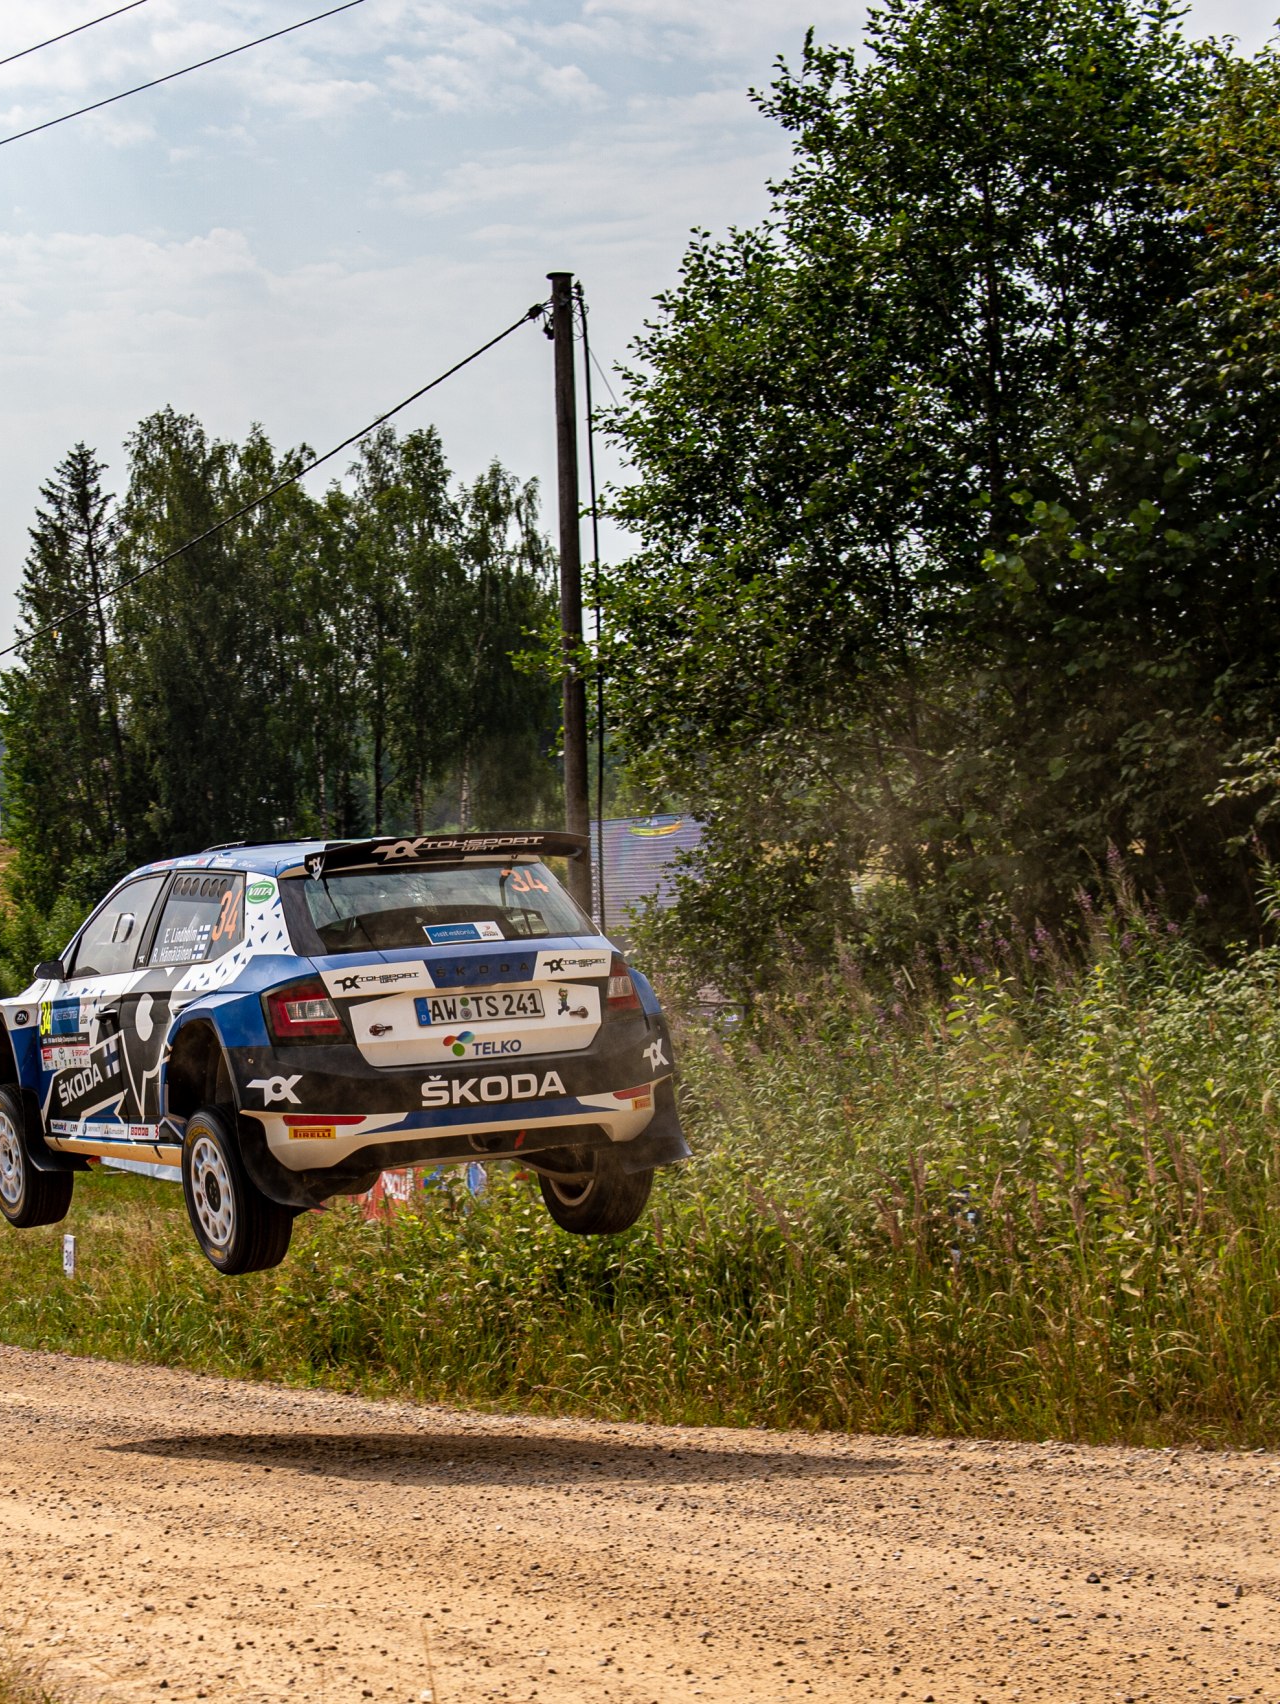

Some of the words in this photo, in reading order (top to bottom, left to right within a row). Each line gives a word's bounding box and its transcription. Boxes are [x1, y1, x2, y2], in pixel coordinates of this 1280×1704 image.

[500, 868, 550, 893] 34
[211, 889, 243, 942] 34
[40, 1000, 51, 1035] 34
[431, 999, 457, 1022] AW
[476, 996, 499, 1018] TS
[504, 993, 542, 1016] 241
[472, 1039, 522, 1056] TELKO
[58, 1063, 104, 1108] ŠKODA
[421, 1071, 567, 1107] ŠKODA
[293, 1128, 332, 1138] PIRELLI
